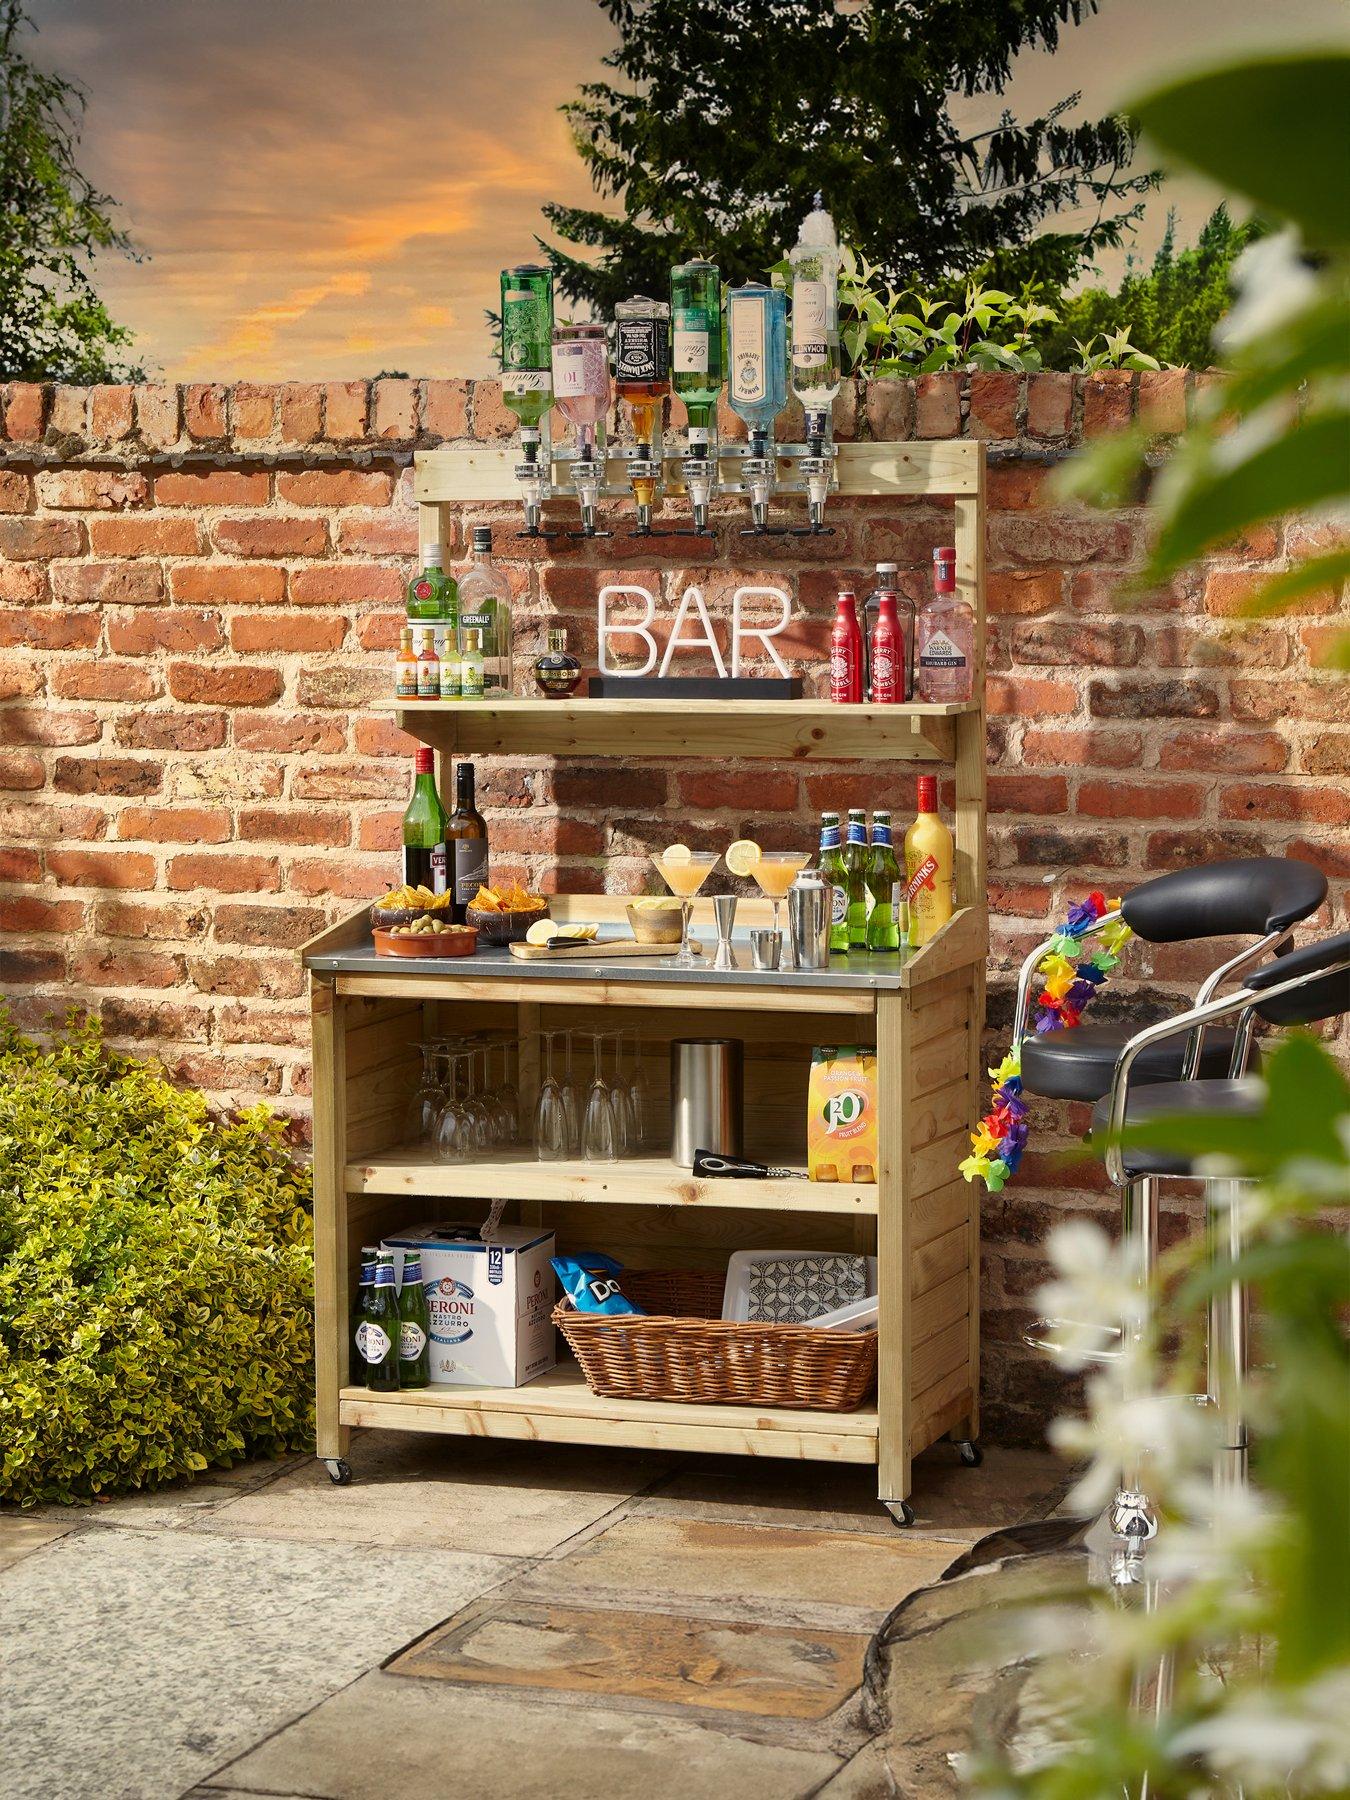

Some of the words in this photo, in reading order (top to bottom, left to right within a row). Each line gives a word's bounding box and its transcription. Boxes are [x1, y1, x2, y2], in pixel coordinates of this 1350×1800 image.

[640, 361, 655, 374] JACK
[598, 585, 792, 679] BAR
[490, 1250, 502, 1265] 12
